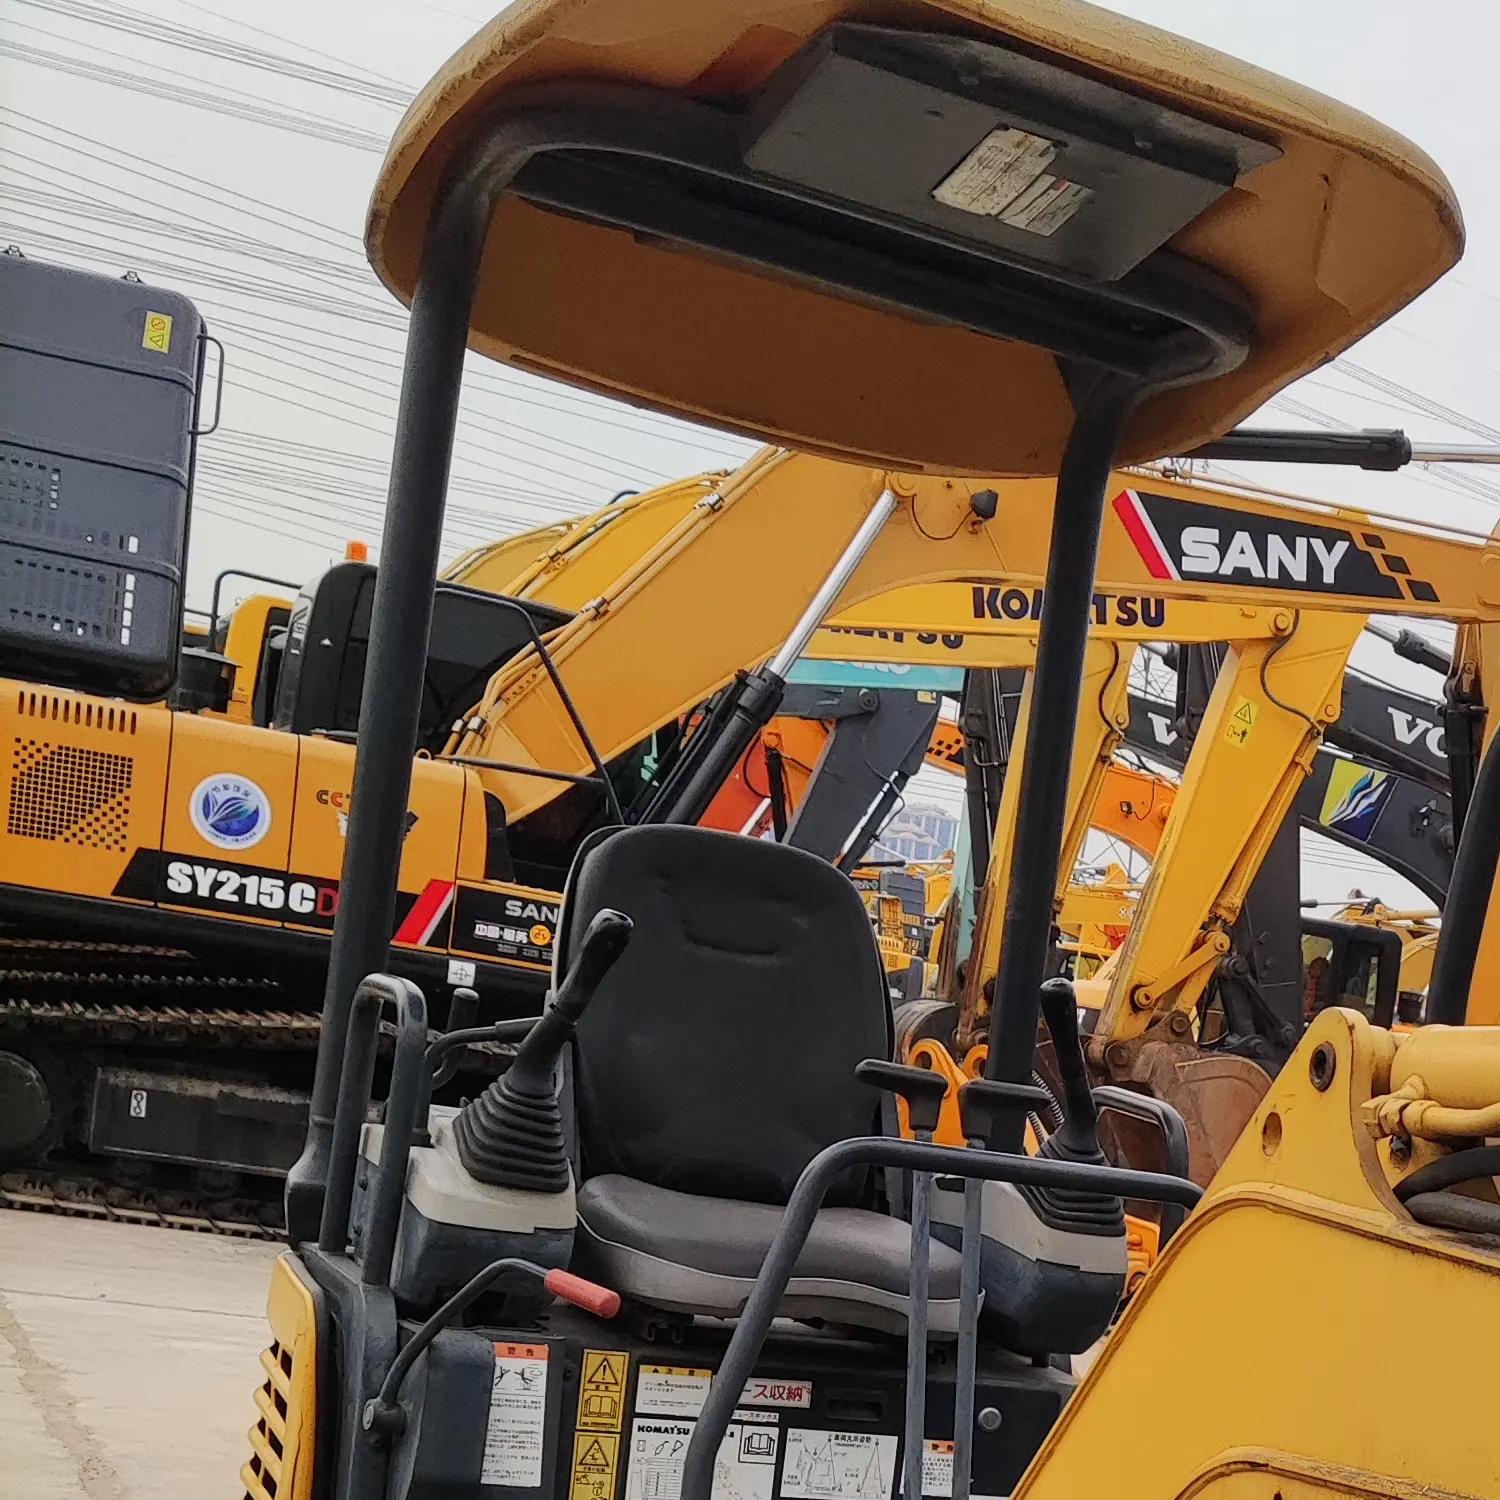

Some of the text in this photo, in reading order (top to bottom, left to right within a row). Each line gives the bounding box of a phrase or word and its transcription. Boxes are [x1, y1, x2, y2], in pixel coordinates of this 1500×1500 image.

[1180, 526, 1350, 585] SANY
[971, 586, 1165, 628] KOTSU
[504, 899, 559, 924] SAN
[637, 1424, 690, 1436] KOMATSU
